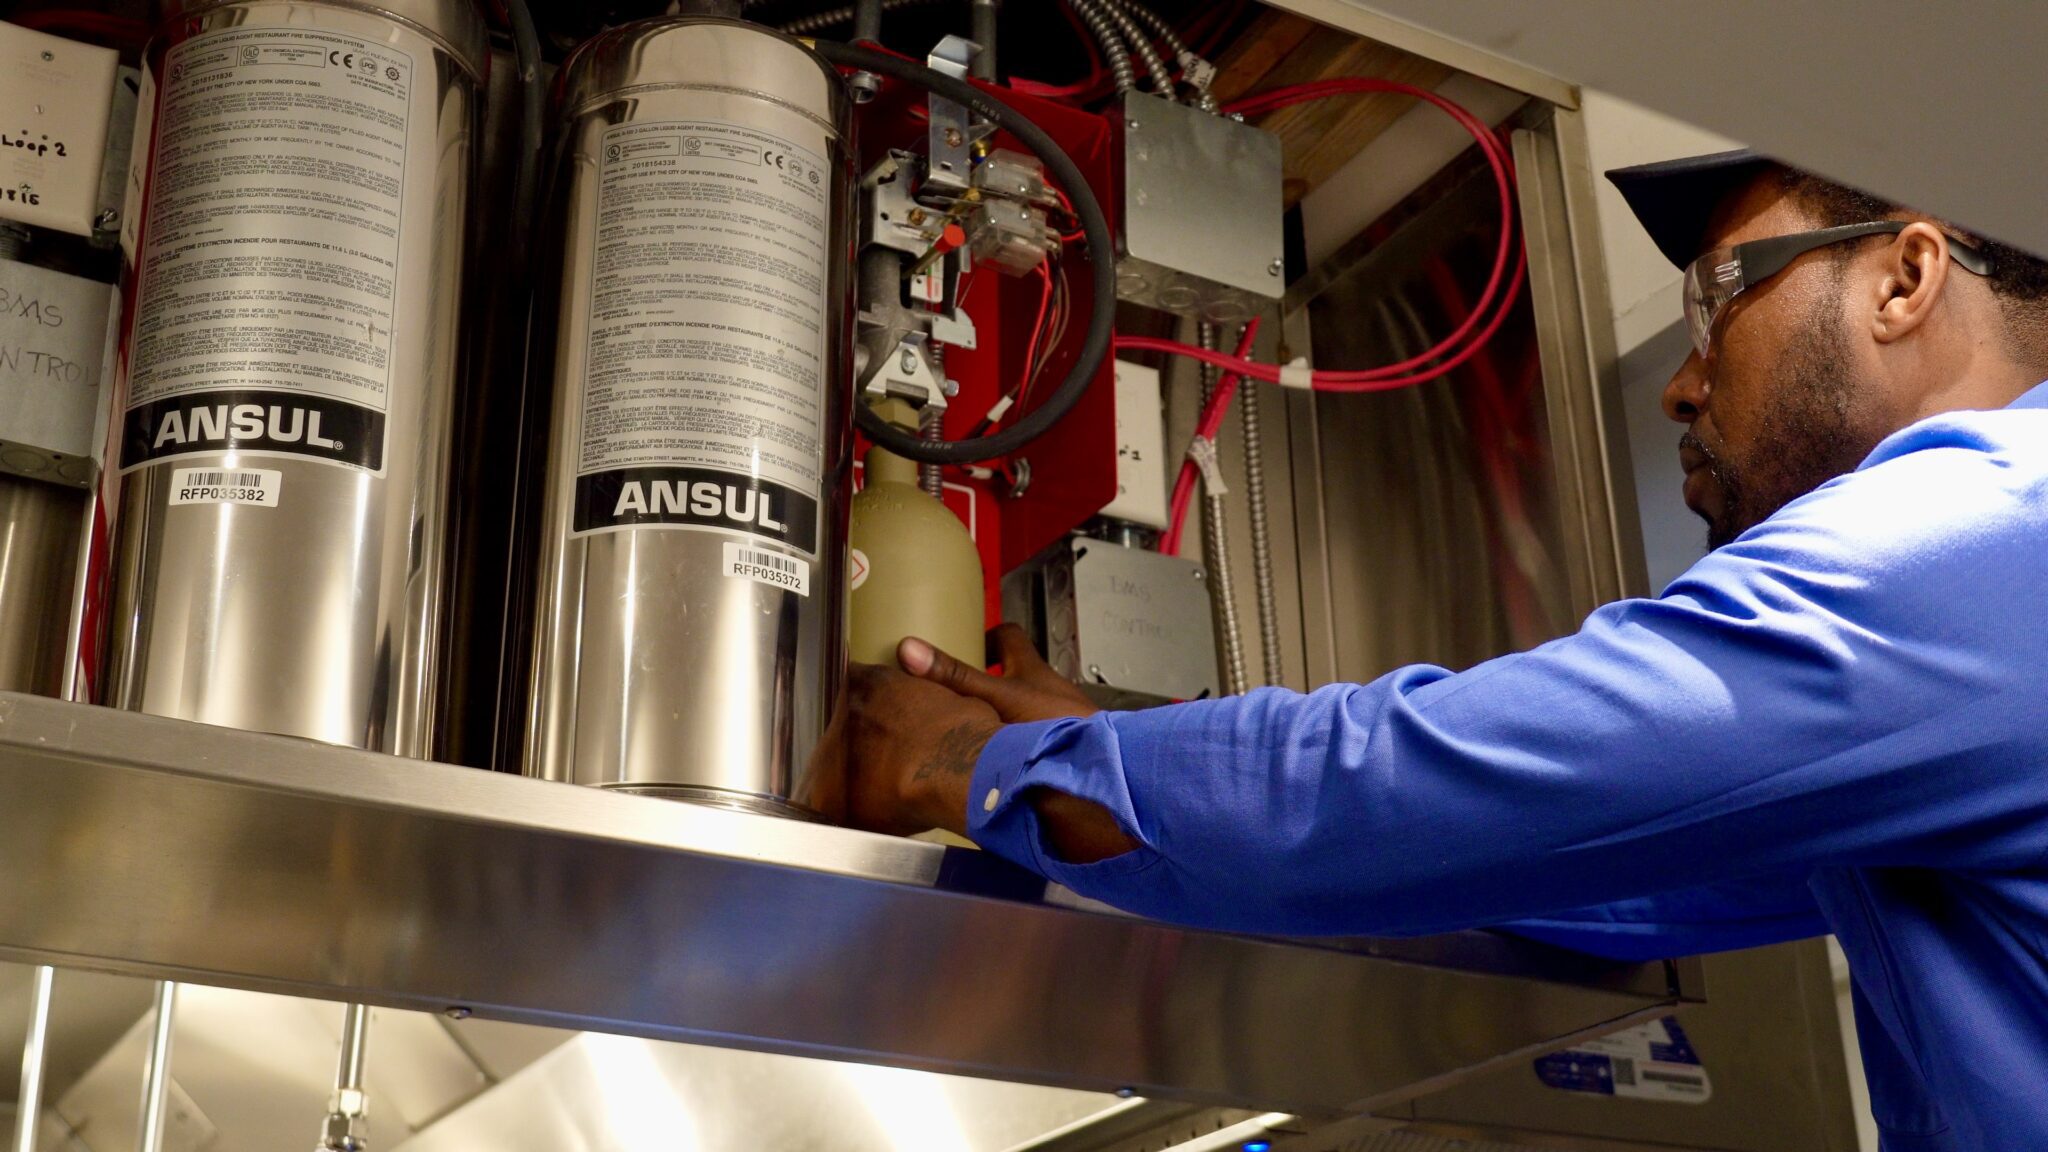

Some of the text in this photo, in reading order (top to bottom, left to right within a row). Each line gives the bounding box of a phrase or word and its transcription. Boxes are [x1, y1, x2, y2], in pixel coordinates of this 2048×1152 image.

[2, 134, 67, 157] Loop 2
[153, 404, 334, 449] ANSUL
[180, 487, 265, 502] RFP035382
[613, 480, 781, 532] ANSUL
[733, 562, 801, 589] RFP035372
